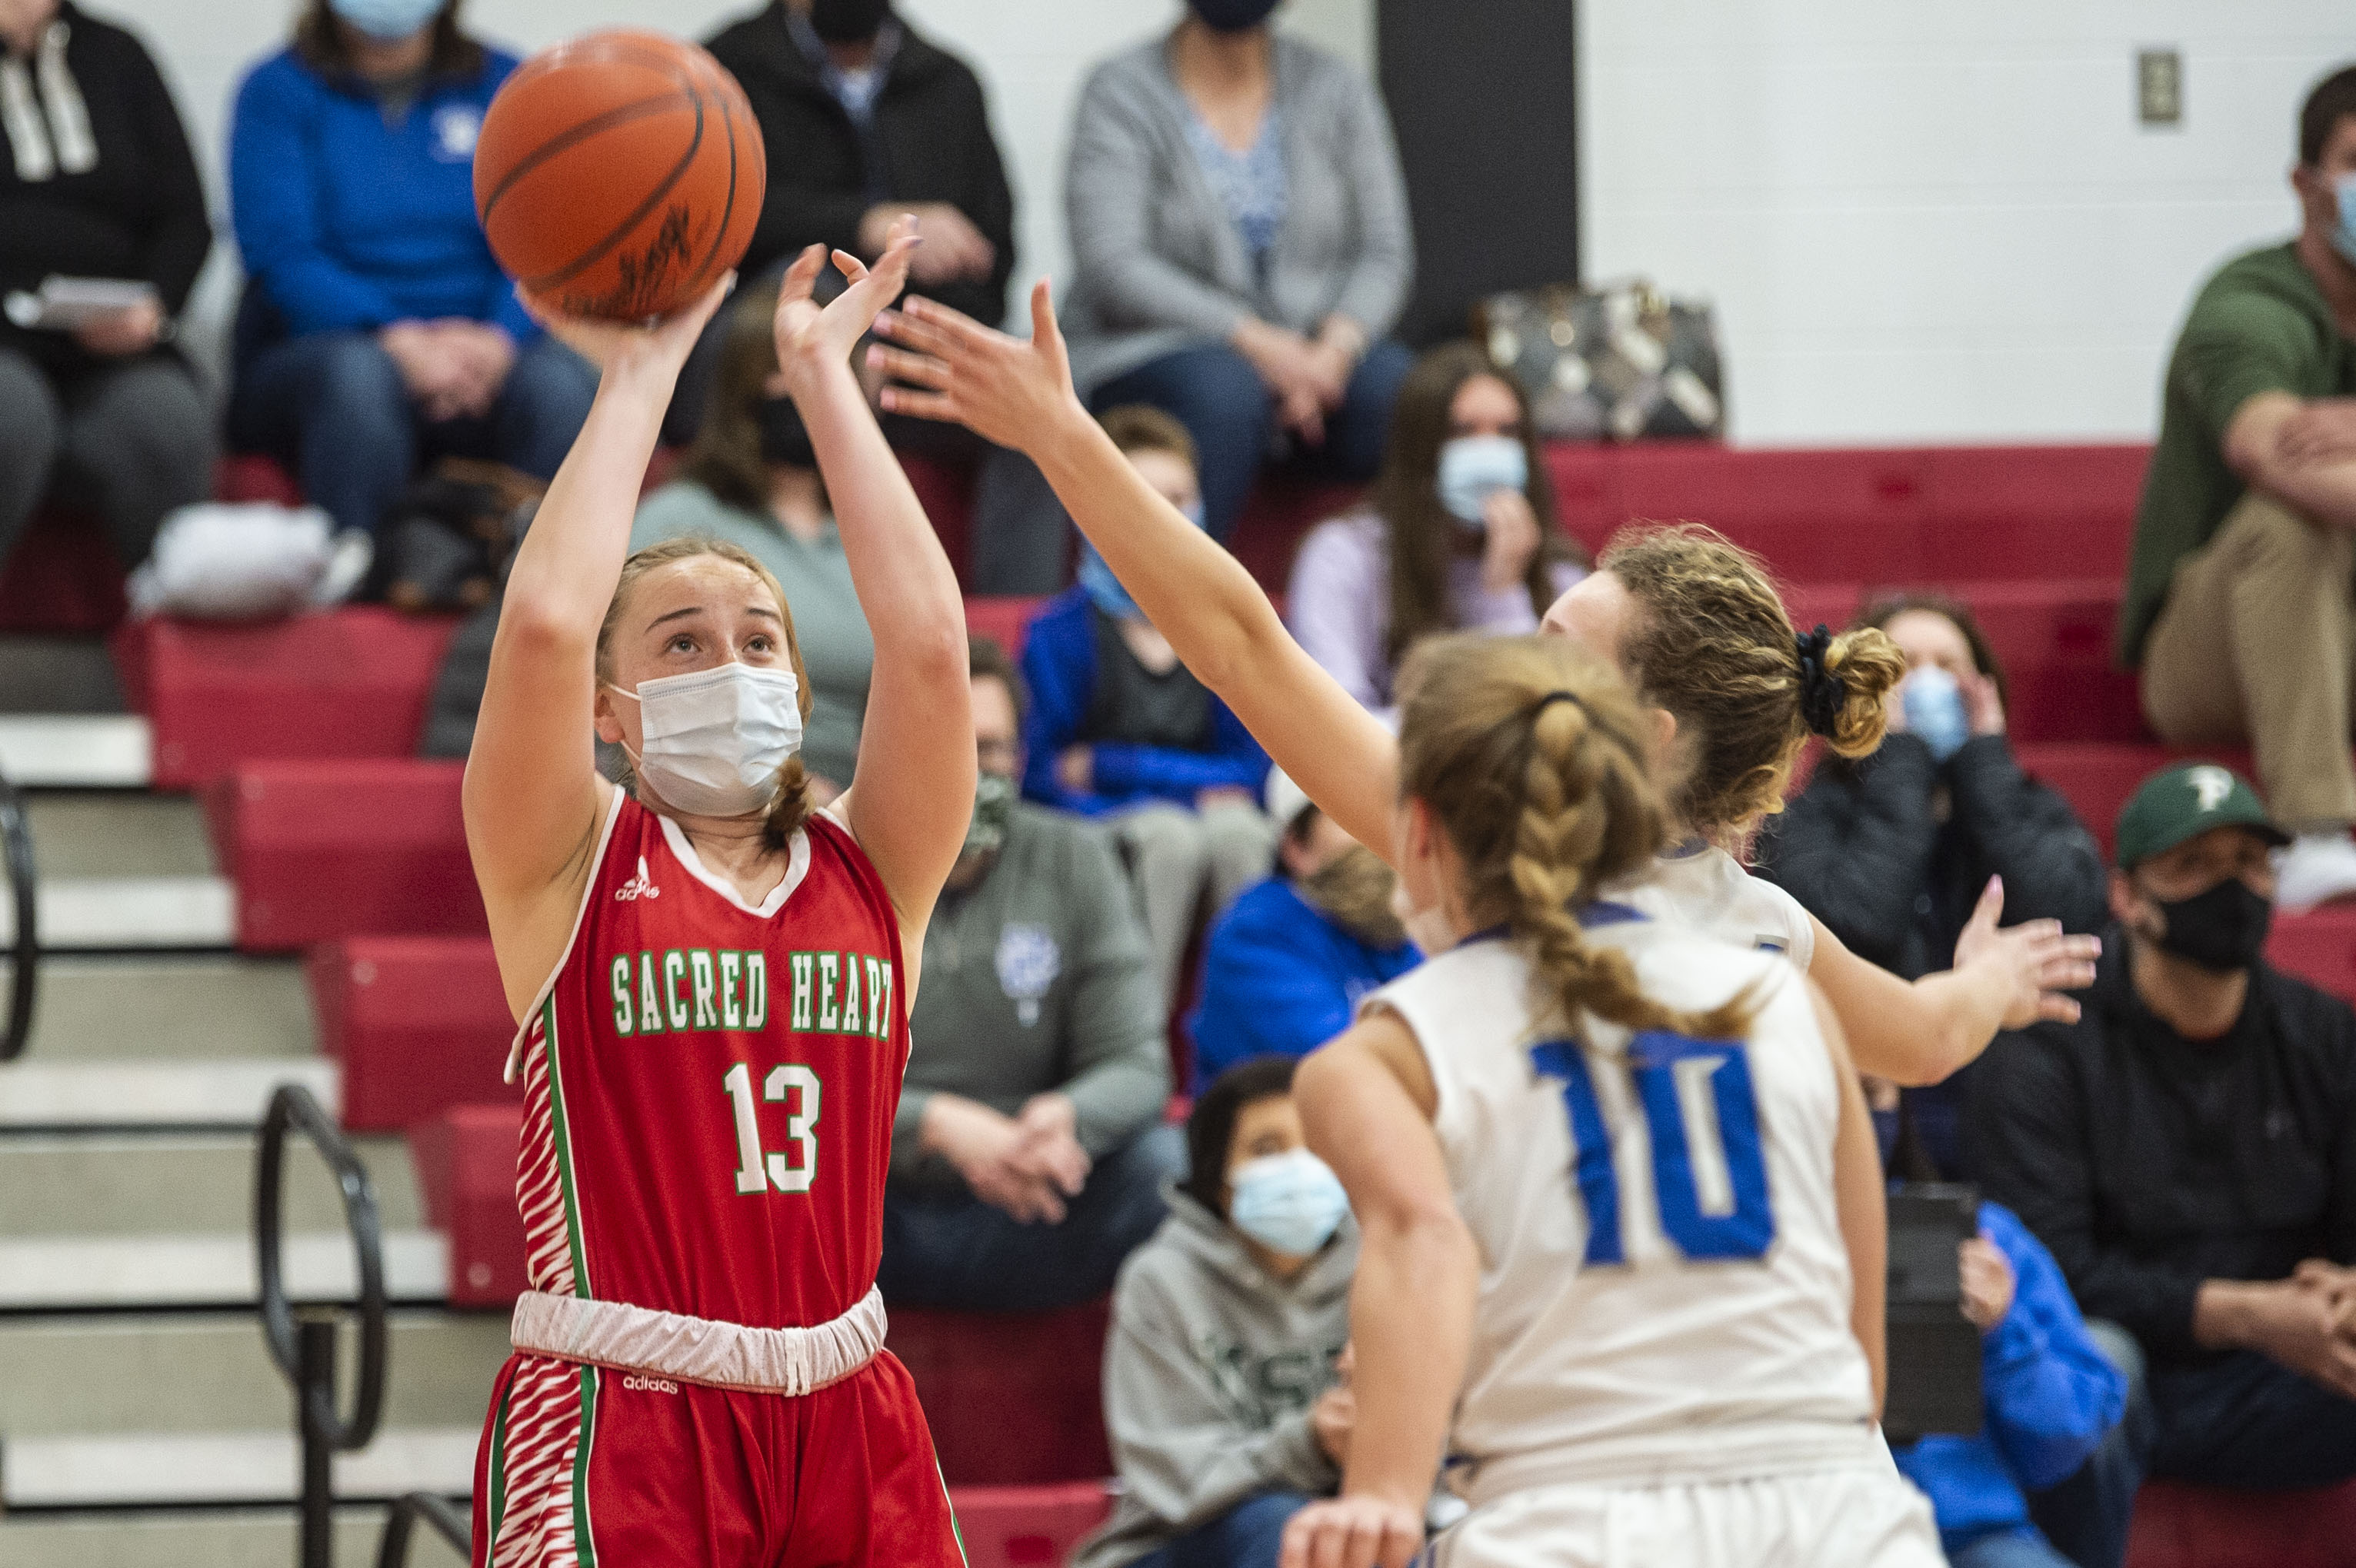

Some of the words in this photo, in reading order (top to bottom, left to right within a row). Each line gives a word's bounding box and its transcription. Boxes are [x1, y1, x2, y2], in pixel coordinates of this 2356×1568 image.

[610, 948, 767, 1037] SACRED
[721, 1061, 822, 1196] 13
[1529, 1030, 1775, 1266] 10
[623, 1374, 678, 1394] adidas
